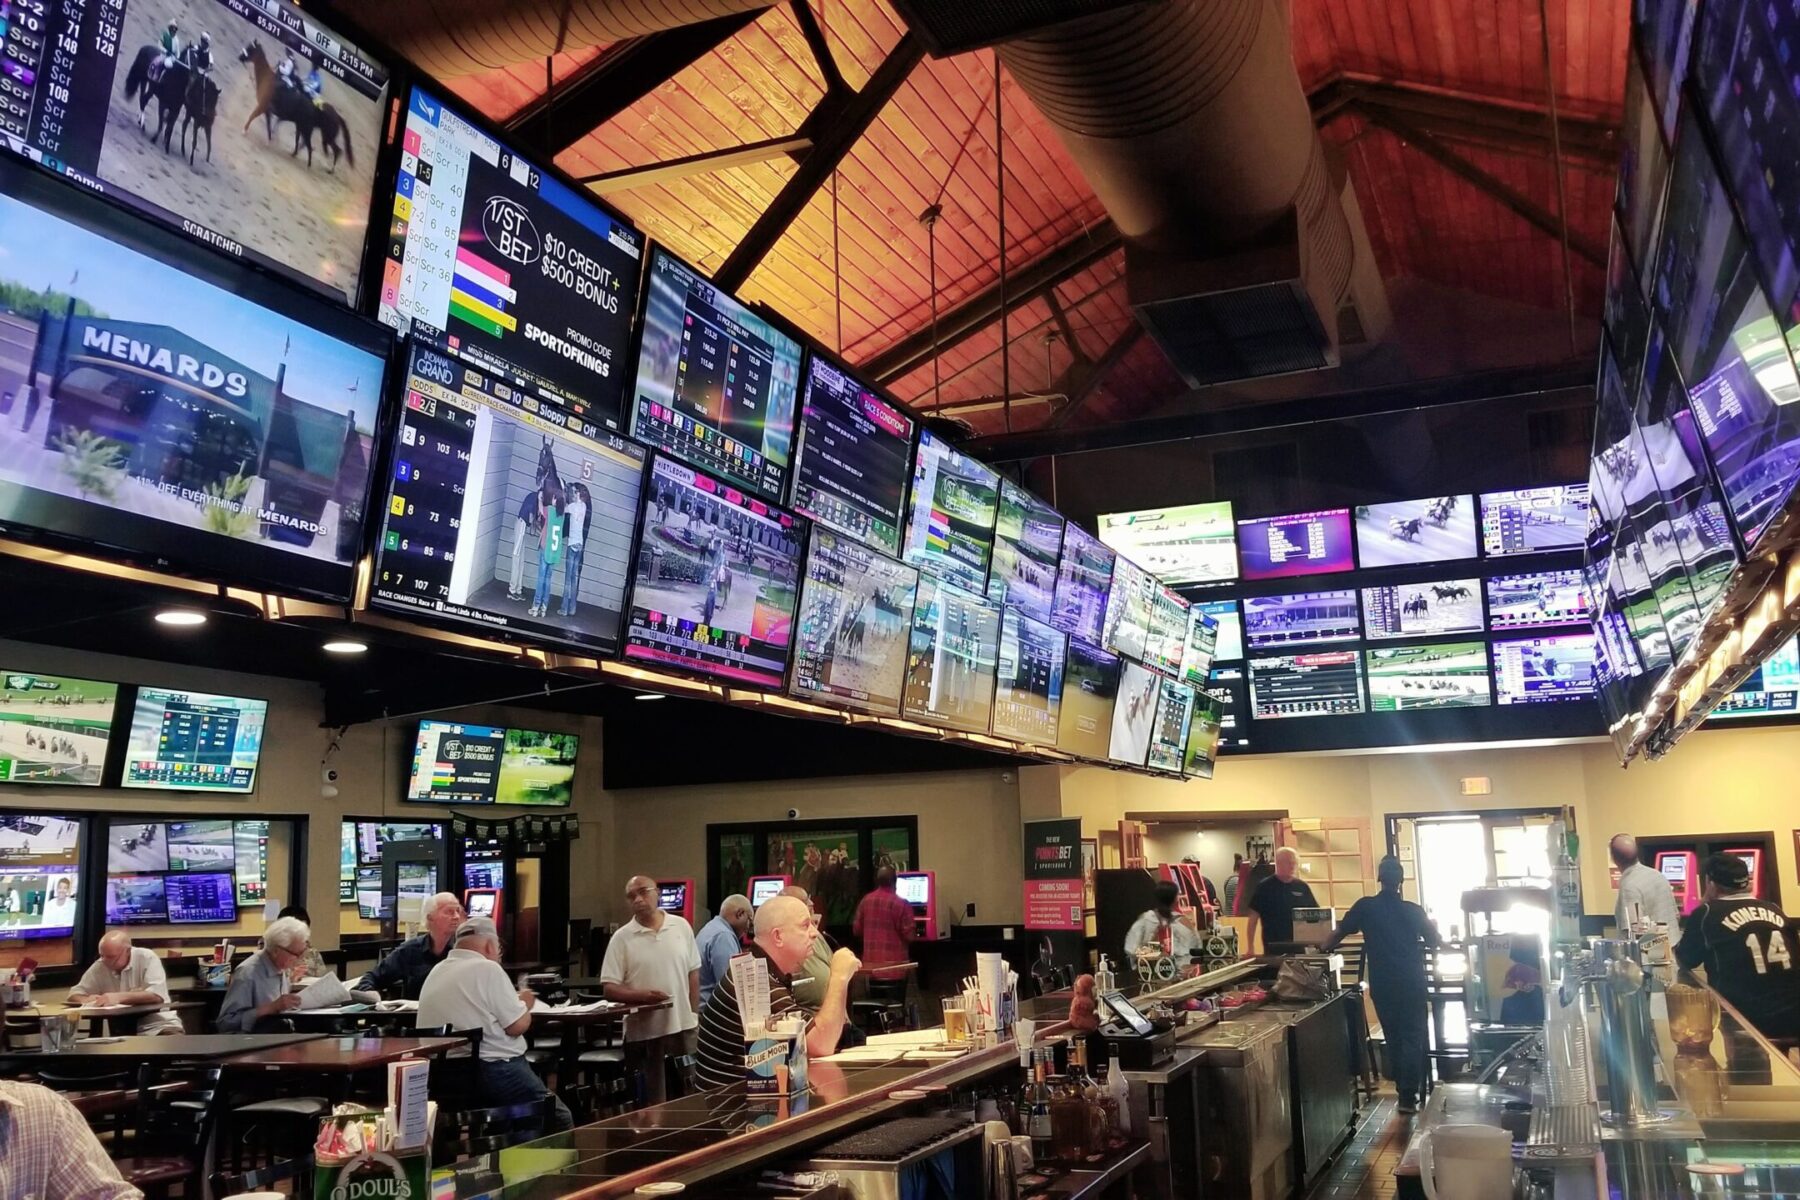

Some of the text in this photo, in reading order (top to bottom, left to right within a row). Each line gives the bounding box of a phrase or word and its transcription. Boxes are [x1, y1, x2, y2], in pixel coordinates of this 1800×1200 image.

[18, 12, 118, 41] 10 71 135
[62, 1, 119, 25] Scr Scr
[257, 15, 281, 37] $5,971
[9, 26, 114, 57] Scr 148 128
[282, 10, 374, 78] Turf OFF 3:15 PM
[6, 44, 74, 71] Scr Scr
[11, 65, 72, 87] 2 Scr
[0, 77, 69, 103] Scr 108
[44, 99, 67, 119] Scr
[41, 115, 63, 136] Scr
[440, 120, 456, 136] PARK
[38, 131, 60, 152] Scr
[441, 110, 479, 140] GULFSTREAM
[501, 154, 509, 169] 6
[529, 171, 540, 190] 12
[410, 136, 416, 148] 1
[421, 142, 434, 158] Scr
[436, 152, 450, 168] Scr
[454, 164, 465, 179] 11
[406, 157, 463, 199] 2 1-5 40
[402, 177, 457, 218] 3 Scr Scr 8
[399, 201, 406, 212] 4
[430, 218, 437, 230] 6
[445, 227, 457, 241] 85
[491, 199, 525, 237] 1/ST
[182, 220, 243, 257] SCRATCHED
[397, 222, 450, 259] 5 Scr Scr 4
[499, 231, 533, 264] BET
[393, 244, 450, 282] 6 Scr Scr 36
[544, 232, 612, 289] $10 CREDIT
[391, 265, 428, 292] 7 4 7
[541, 255, 618, 315] $500 BONUS
[387, 288, 429, 316] 8 Scr Scr
[415, 320, 434, 336] RACE
[495, 324, 501, 335] 5
[524, 322, 611, 378] SPORTOFKINGS
[566, 327, 613, 361] PROMO CODE
[82, 325, 248, 398] MENARDS
[416, 358, 453, 385] GRAND
[424, 350, 449, 369] INDIANA
[413, 380, 434, 394] ODDS
[420, 398, 436, 417] 2/5
[447, 410, 456, 421] 31
[465, 419, 476, 429] 47
[512, 391, 521, 405] 10
[540, 404, 567, 426] Sloppy
[583, 424, 597, 438] Off
[608, 434, 624, 451] 3:15
[864, 400, 876, 415] RACE
[663, 410, 672, 421] 1A
[686, 420, 692, 431] 3
[707, 431, 713, 442] 5
[717, 436, 722, 447] 6
[406, 431, 470, 463] 2 9 103 144
[400, 465, 465, 495] 3 9 Scr
[583, 461, 592, 479] 5
[654, 460, 692, 481] THISTLEDOWN
[766, 463, 778, 476] PICK
[1520, 490, 1532, 499] 45
[181, 488, 240, 512] EVERYTHING
[241, 505, 253, 516] AT
[257, 507, 328, 536] MENARDS
[407, 504, 460, 529] 8 73 56
[389, 536, 454, 562] 5 6 85 86
[551, 525, 561, 551] 5
[378, 589, 393, 599] RACE
[393, 592, 418, 605] CHANGES
[383, 571, 449, 596] 6 7 107 72
[665, 625, 676, 636] 7/2
[681, 630, 691, 640] 7/2
[474, 745, 492, 753] CREDIT
[476, 753, 495, 761] BONUS
[1721, 906, 1785, 932] KONERKO
[1745, 930, 1792, 974] 14
[746, 1043, 788, 1069] BLUE MOON
